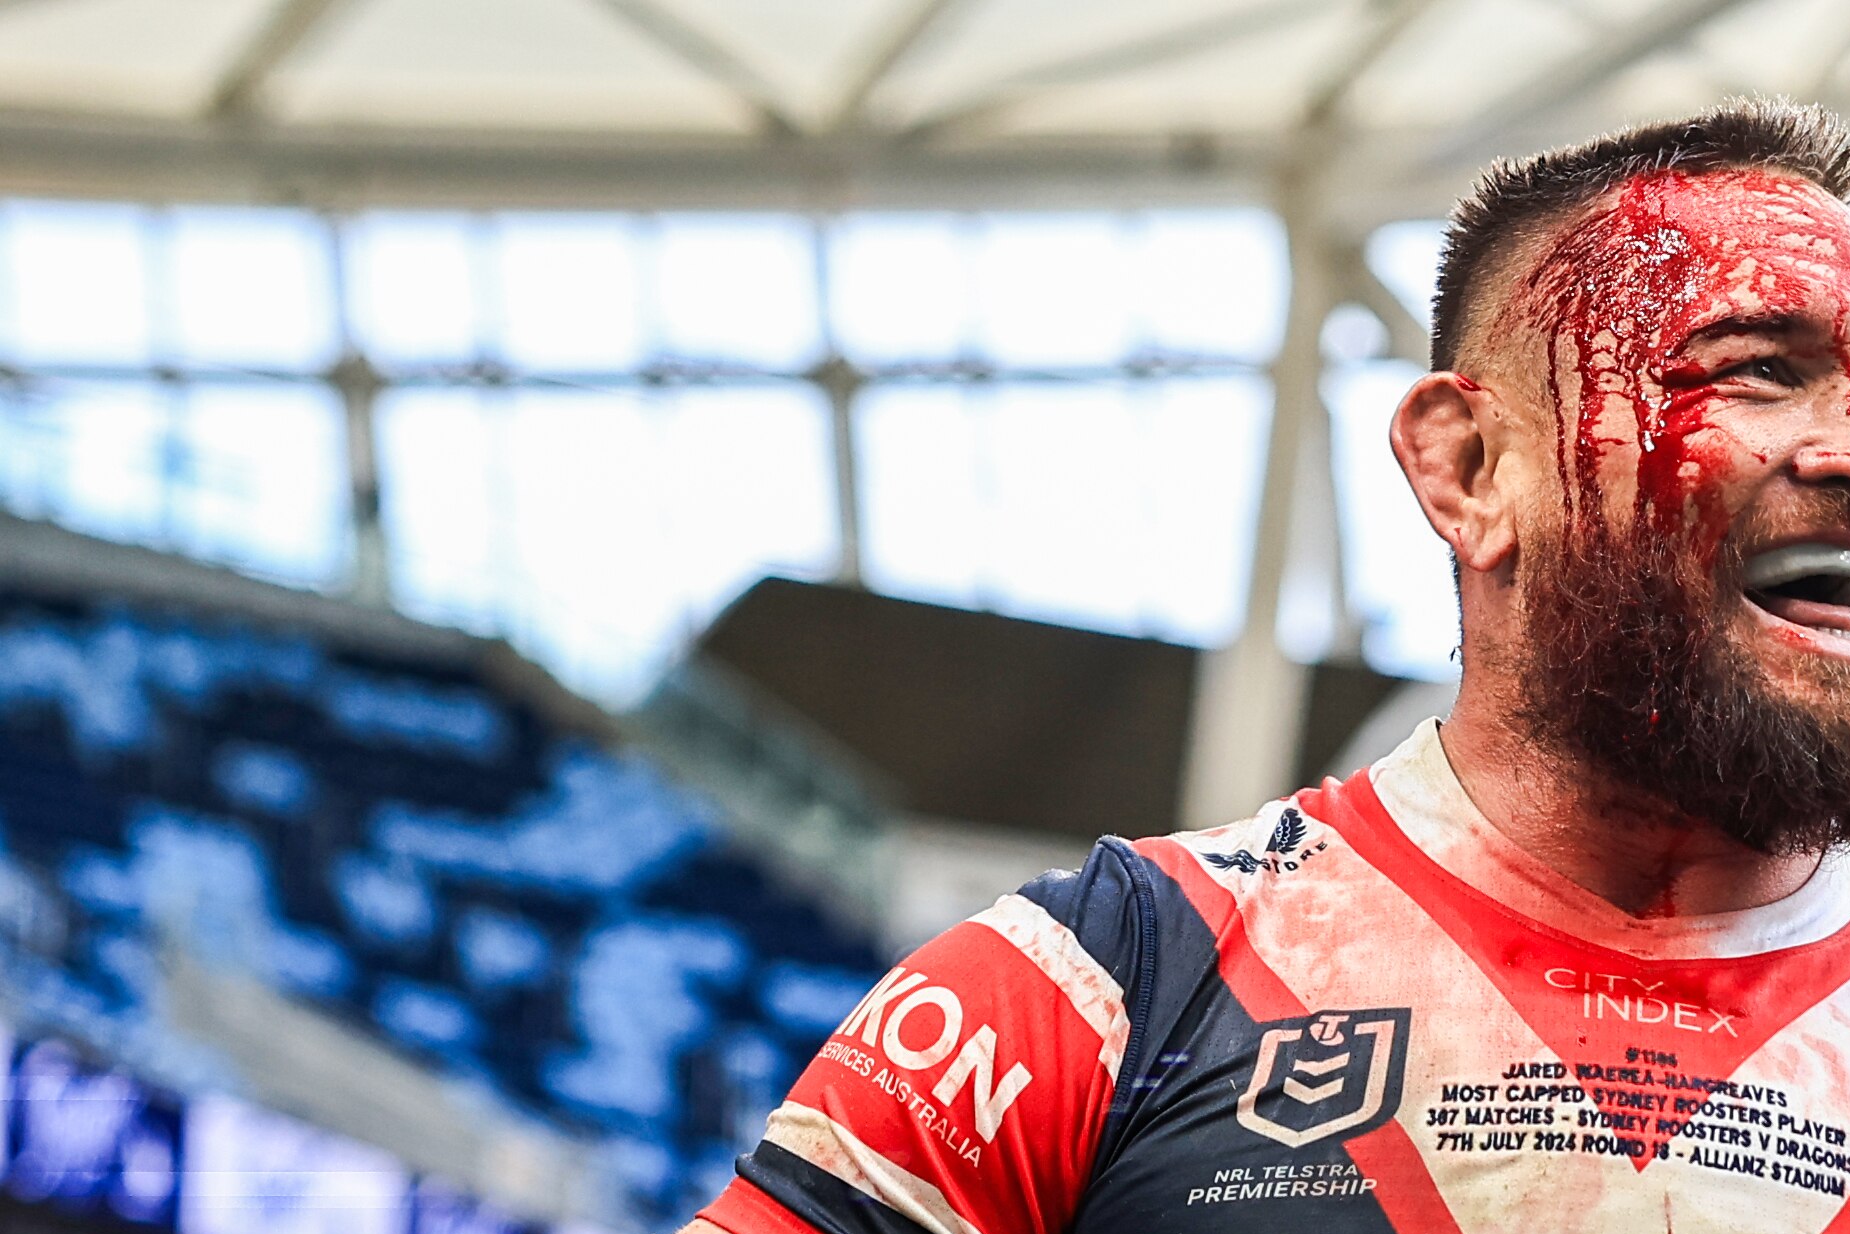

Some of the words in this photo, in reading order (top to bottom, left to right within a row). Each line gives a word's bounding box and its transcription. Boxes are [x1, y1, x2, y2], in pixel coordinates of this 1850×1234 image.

[1544, 967, 1664, 996] CITY
[1584, 993, 1739, 1038] INDEX
[1502, 1062, 1567, 1080] JARED
[818, 1042, 876, 1077] SERVICES
[872, 1068, 982, 1168] AUSTRALIA
[1441, 1085, 1499, 1103] MOST
[1505, 1085, 1586, 1103] CAPPED
[1593, 1087, 1667, 1112] SYDNEY
[1674, 1097, 1772, 1128] ROOSTERS
[1777, 1113, 1847, 1147] PLAYER
[1465, 1107, 1555, 1126] MATCHES
[1577, 1109, 1649, 1132] SYDNEY
[1656, 1119, 1752, 1148] ROOSTERS
[1758, 1132, 1771, 1151] V
[1214, 1168, 1255, 1183] NRL
[1263, 1163, 1358, 1180] TELSTRA
[1436, 1132, 1474, 1151] 7TH
[1479, 1131, 1527, 1151] JULY
[1533, 1133, 1577, 1152] 2024
[1581, 1135, 1647, 1158] ROUND
[1689, 1146, 1765, 1178] ALLIANZ
[1771, 1162, 1846, 1197] STADIUM
[1187, 1179, 1377, 1206] PREMIERSHIP
